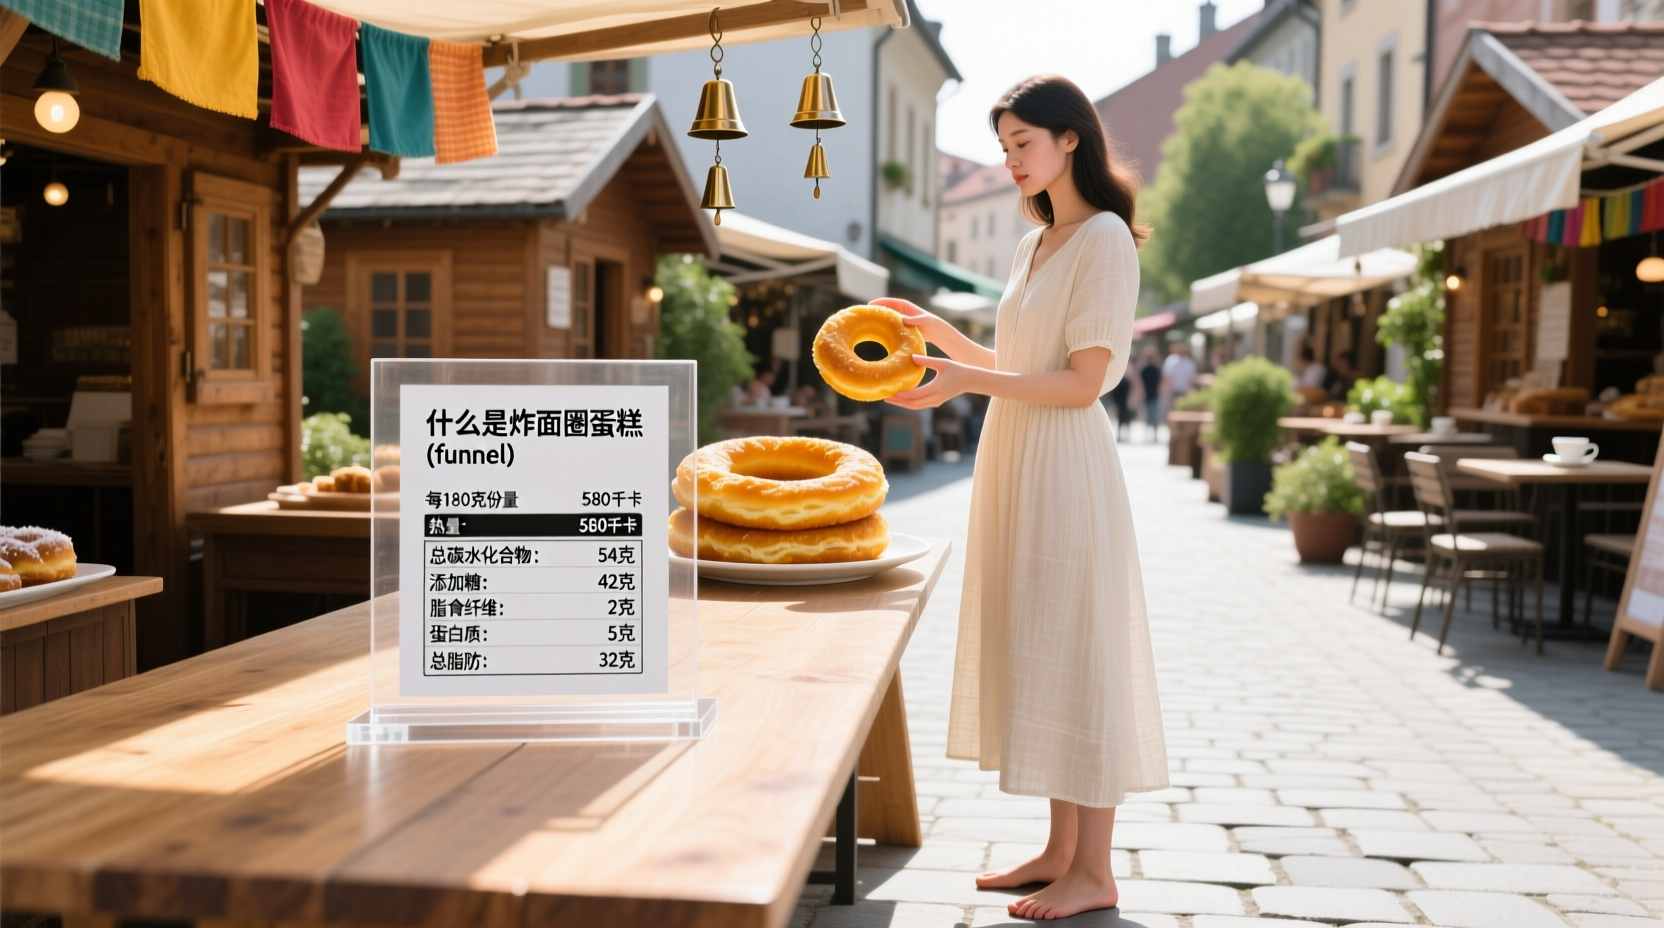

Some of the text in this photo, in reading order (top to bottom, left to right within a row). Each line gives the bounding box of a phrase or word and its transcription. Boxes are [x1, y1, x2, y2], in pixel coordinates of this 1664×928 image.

[426, 408, 643, 438] 什么是炸面圈蛋糕
[426, 443, 515, 469] (funnel)
[581, 490, 642, 508] 580千卡
[598, 545, 636, 564] 54克
[598, 572, 636, 591] 42克
[608, 597, 636, 616] 2克
[607, 623, 636, 643] 5克
[599, 650, 636, 670] 32克
